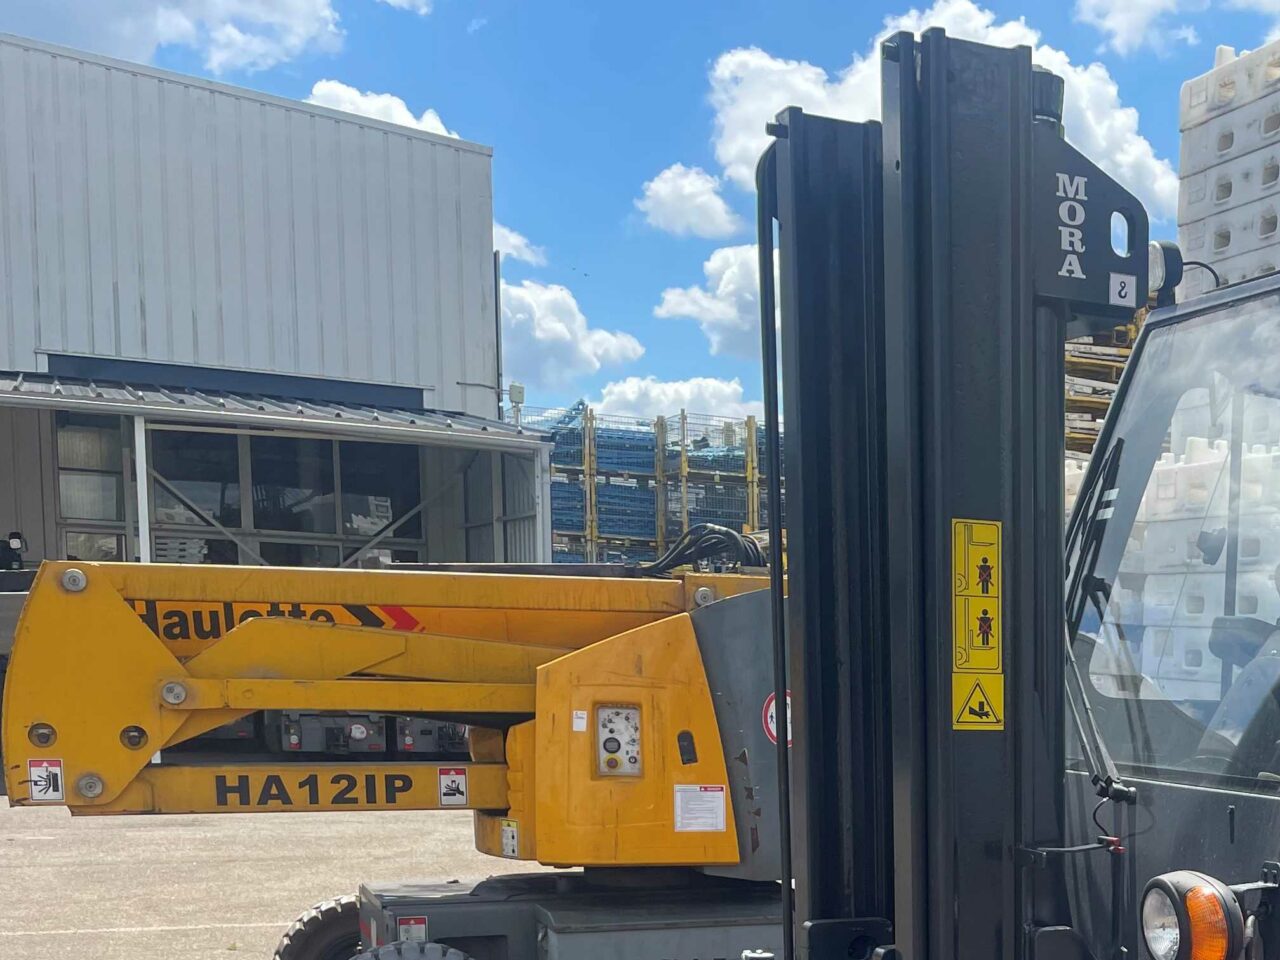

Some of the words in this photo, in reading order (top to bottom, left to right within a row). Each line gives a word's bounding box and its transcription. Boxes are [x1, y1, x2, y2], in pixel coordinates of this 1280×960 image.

[1055, 172, 1088, 279] MORA
[126, 600, 336, 640] Haul
[215, 774, 413, 806] HA12IP
